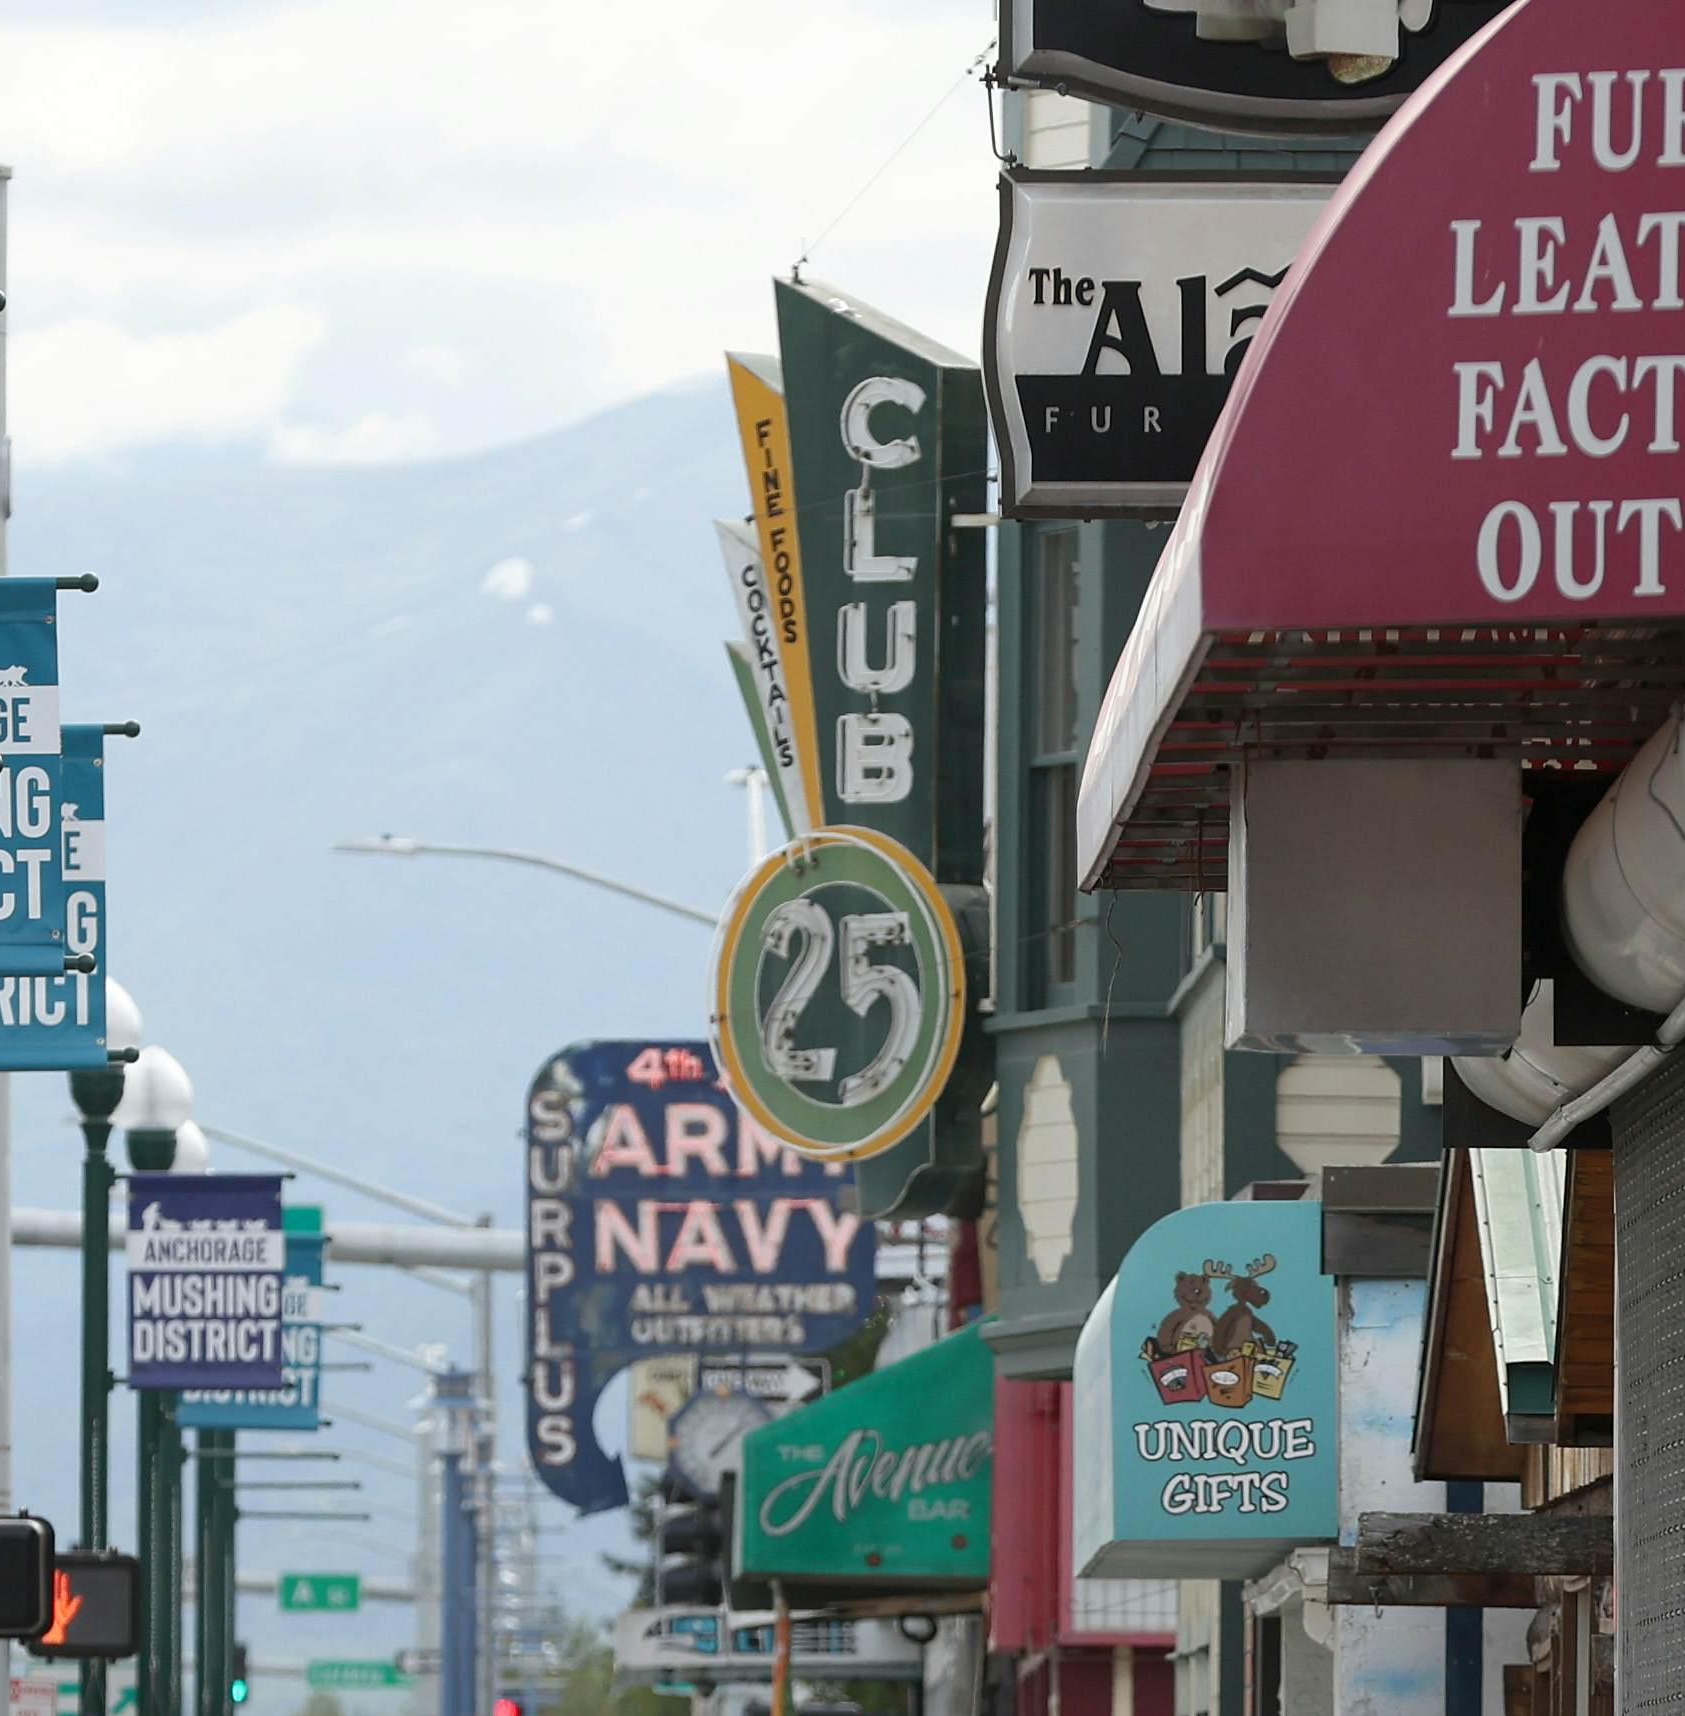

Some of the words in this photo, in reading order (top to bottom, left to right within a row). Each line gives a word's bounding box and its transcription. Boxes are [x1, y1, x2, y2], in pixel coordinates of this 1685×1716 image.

[1028, 268, 1095, 307] The
[755, 417, 784, 519] FINE
[770, 527, 798, 644] FOODS
[835, 376, 926, 804] CLUB
[741, 564, 794, 768] COCKTAILS
[759, 898, 923, 1106] 25
[627, 1048, 704, 1090] 4th
[587, 1102, 846, 1178] ARM
[144, 1238, 268, 1263] ANCHORAGE
[594, 1198, 860, 1274] NAVY
[132, 1274, 279, 1318] MUSHING
[530, 1091, 578, 1466] SURPLUS
[132, 1318, 278, 1362] DISTRICT
[777, 1445, 825, 1462] THE
[1134, 1418, 1316, 1465] UNIQUE
[760, 1428, 994, 1537] Avenue
[1161, 1471, 1290, 1516] GIFTS
[907, 1497, 971, 1520] BAR
